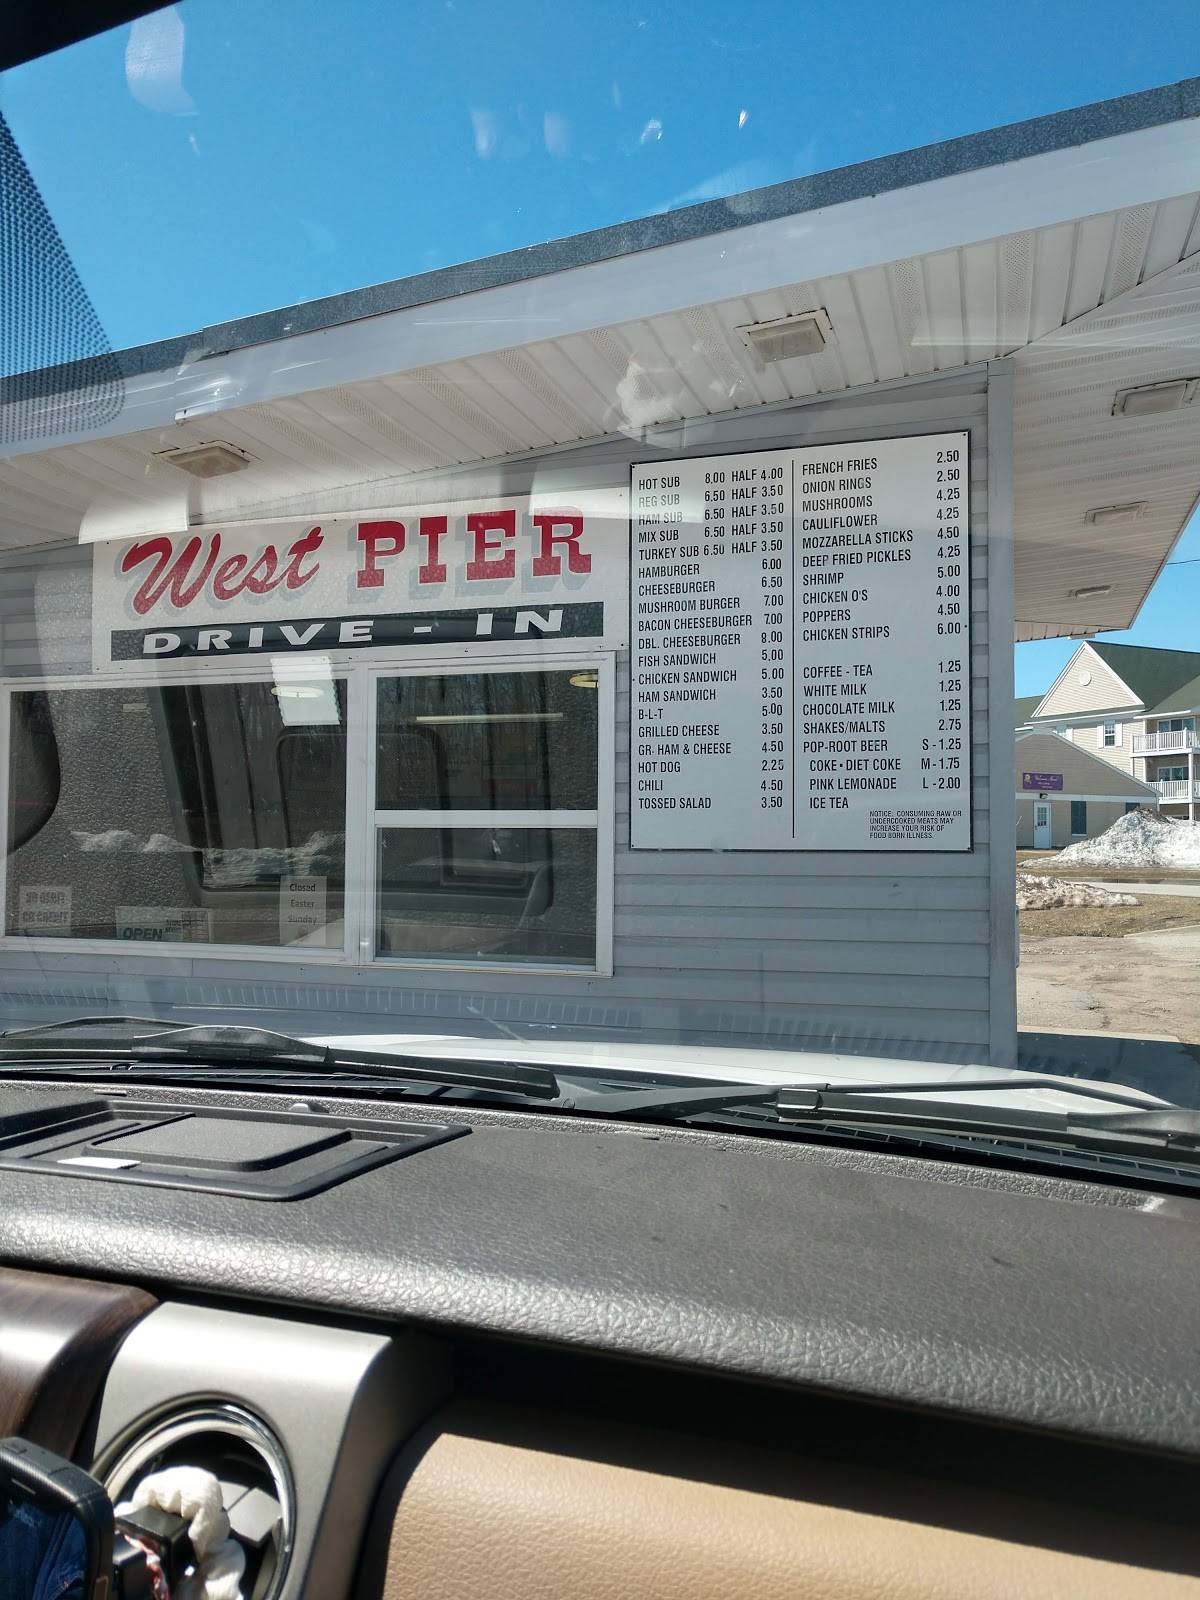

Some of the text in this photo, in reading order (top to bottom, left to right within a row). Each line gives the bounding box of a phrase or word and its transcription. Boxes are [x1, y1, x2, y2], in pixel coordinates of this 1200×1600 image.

[803, 450, 959, 475] FRENCH FRIES 2.50
[639, 468, 782, 490] HOT SUB 8.00 HALF 4.00
[803, 469, 959, 494] ONION RINGS 2.50
[639, 485, 783, 507] REG SUB 6.50 HALF 3.50
[803, 488, 960, 512] MUSHROOMS 4.25
[639, 503, 783, 525] HAM SUB 6.50 HALF 3.50
[803, 507, 959, 530] CAULIFLOWER 4.25
[639, 522, 783, 543] MIX SUB 6.50 HALF 3.50
[803, 526, 959, 549] MOZZARELLA STICKS 4.50
[639, 540, 782, 560] TURKEY SUB 6.50 HALF 3.50
[803, 545, 960, 567] DEEP FRIED PICKLES 4.25
[121, 508, 592, 615] West PIER
[639, 559, 781, 578] HAMBURGER 6.00
[803, 565, 960, 585] SHRIMP 5.00
[639, 576, 782, 596] CHEESEBURGER 6.50
[803, 585, 959, 604] CHICKEN O'S 4.00
[639, 595, 783, 614] MUSHROOM BURGER 7.00
[803, 603, 960, 622] POPPERS 4.50
[142, 619, 374, 654] DRIVE
[475, 609, 563, 636] IN
[639, 613, 782, 632] BACON CHEESEBURGER 7.00
[803, 622, 960, 641] CHICKEN STRIPS 6.00
[639, 631, 782, 649] DBL. CHEESEBURGER 8.00
[639, 649, 783, 667] FISH SANDWICH 5.00
[639, 668, 784, 684] CHICKEN SANDWICH 5.00
[804, 666, 842, 678] COFFEE
[853, 665, 872, 676] TEA
[939, 660, 960, 672] 1.25
[639, 687, 782, 702] HAM SANDWICH 3.50
[804, 680, 961, 696] WHITE MILK 1.25
[639, 703, 782, 720] B-L-T 5.00
[803, 699, 960, 716] CHOCOLATE MILK 1.25
[639, 723, 782, 737] GRILLED CHEESE 3.50
[804, 719, 961, 734] SHAKES/MALTS 2.75
[658, 744, 679, 755] HAM
[683, 744, 689, 754] &
[694, 743, 731, 754] CHEESE
[762, 741, 783, 752] 4.50
[804, 741, 857, 752] POP-ROOT
[861, 740, 887, 751] BEER
[639, 760, 784, 773] HOT DOG 2.25
[810, 760, 836, 771] COKE
[846, 759, 869, 770] DIET
[873, 759, 900, 770] COKE
[639, 780, 782, 791] CHILI 4.50
[810, 779, 834, 790] PINK
[838, 778, 896, 789] LEMONADE
[639, 796, 782, 809] TOSSED SALAD 3.50
[810, 797, 848, 808] ICE TEA
[289, 883, 316, 892] Closed
[290, 899, 314, 908] Easter
[123, 927, 163, 939] OPEN
